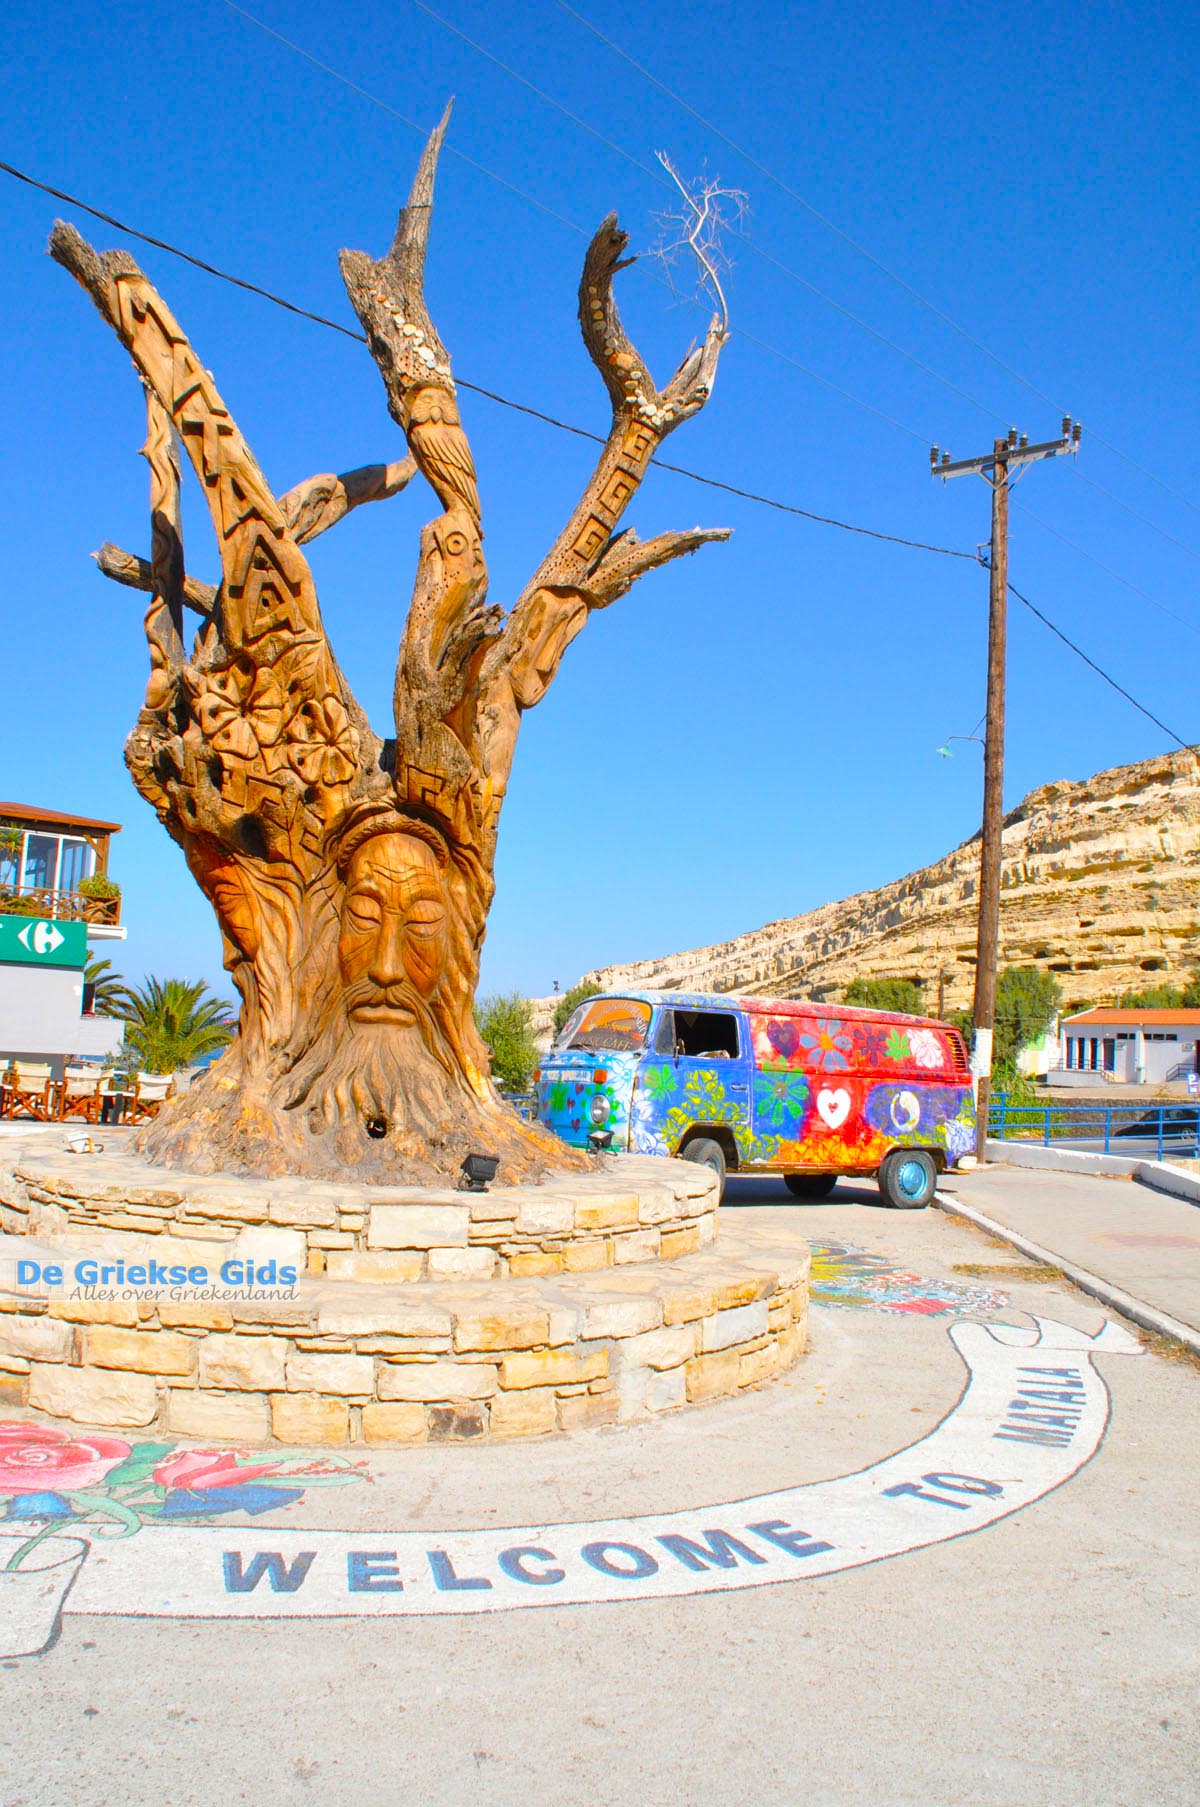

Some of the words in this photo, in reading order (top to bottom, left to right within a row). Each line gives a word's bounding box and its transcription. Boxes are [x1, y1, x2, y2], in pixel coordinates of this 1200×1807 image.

[222, 1519, 835, 1593] WELCOME
[880, 1472, 1004, 1511] TO
[992, 1366, 1087, 1449] MATALA
